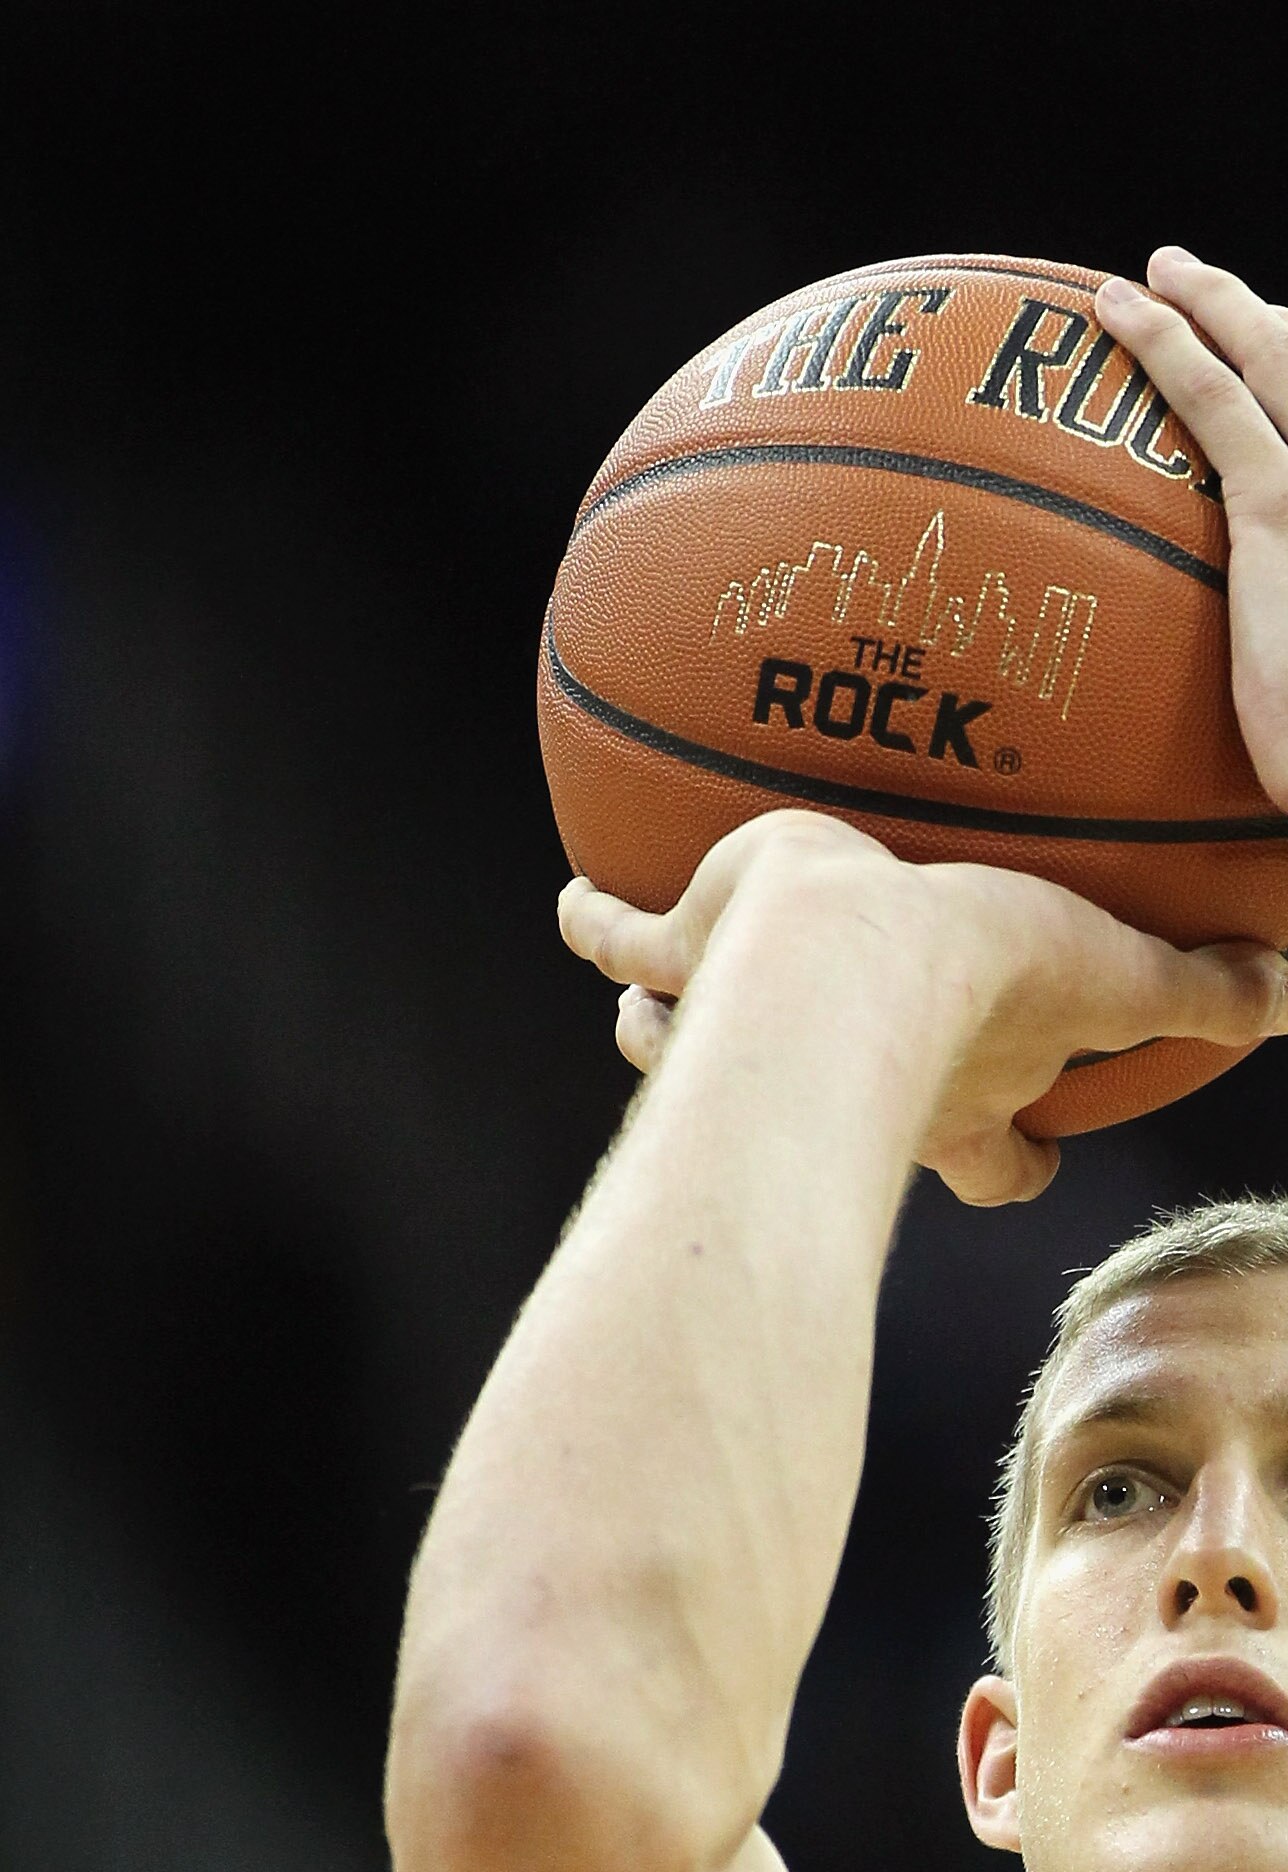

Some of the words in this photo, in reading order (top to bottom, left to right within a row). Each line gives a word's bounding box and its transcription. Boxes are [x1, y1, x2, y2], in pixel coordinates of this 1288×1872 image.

[699, 287, 955, 410] THE
[965, 294, 1222, 504] ROC
[752, 657, 993, 771] ROCK
[850, 636, 927, 681] THE
